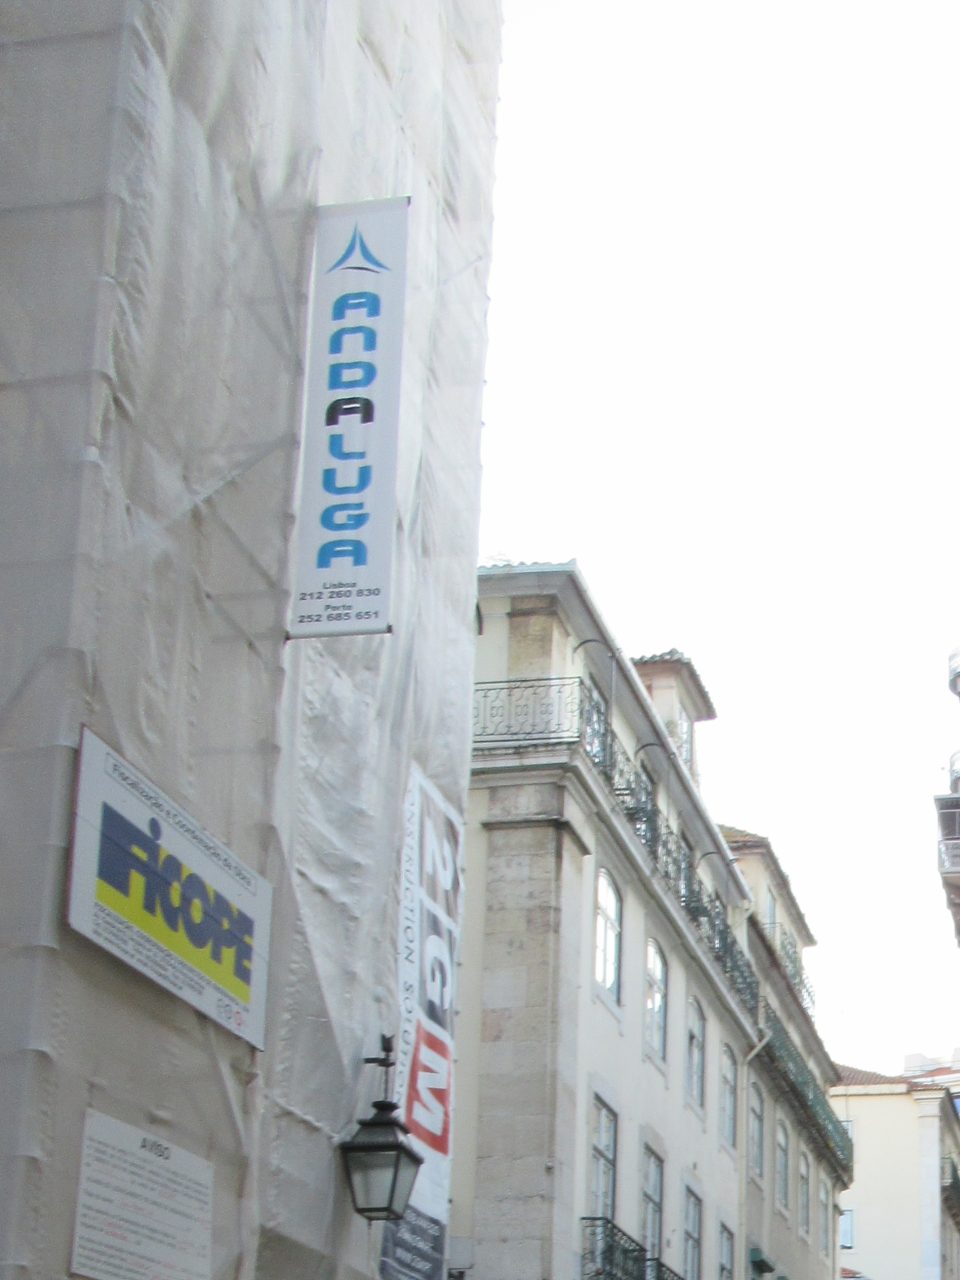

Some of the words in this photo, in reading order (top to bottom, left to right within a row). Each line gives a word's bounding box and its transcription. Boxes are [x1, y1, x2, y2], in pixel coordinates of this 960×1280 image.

[316, 291, 382, 569] ANDALUGA
[299, 591, 324, 601] 212
[297, 614, 322, 624] 252
[355, 610, 379, 621] 651
